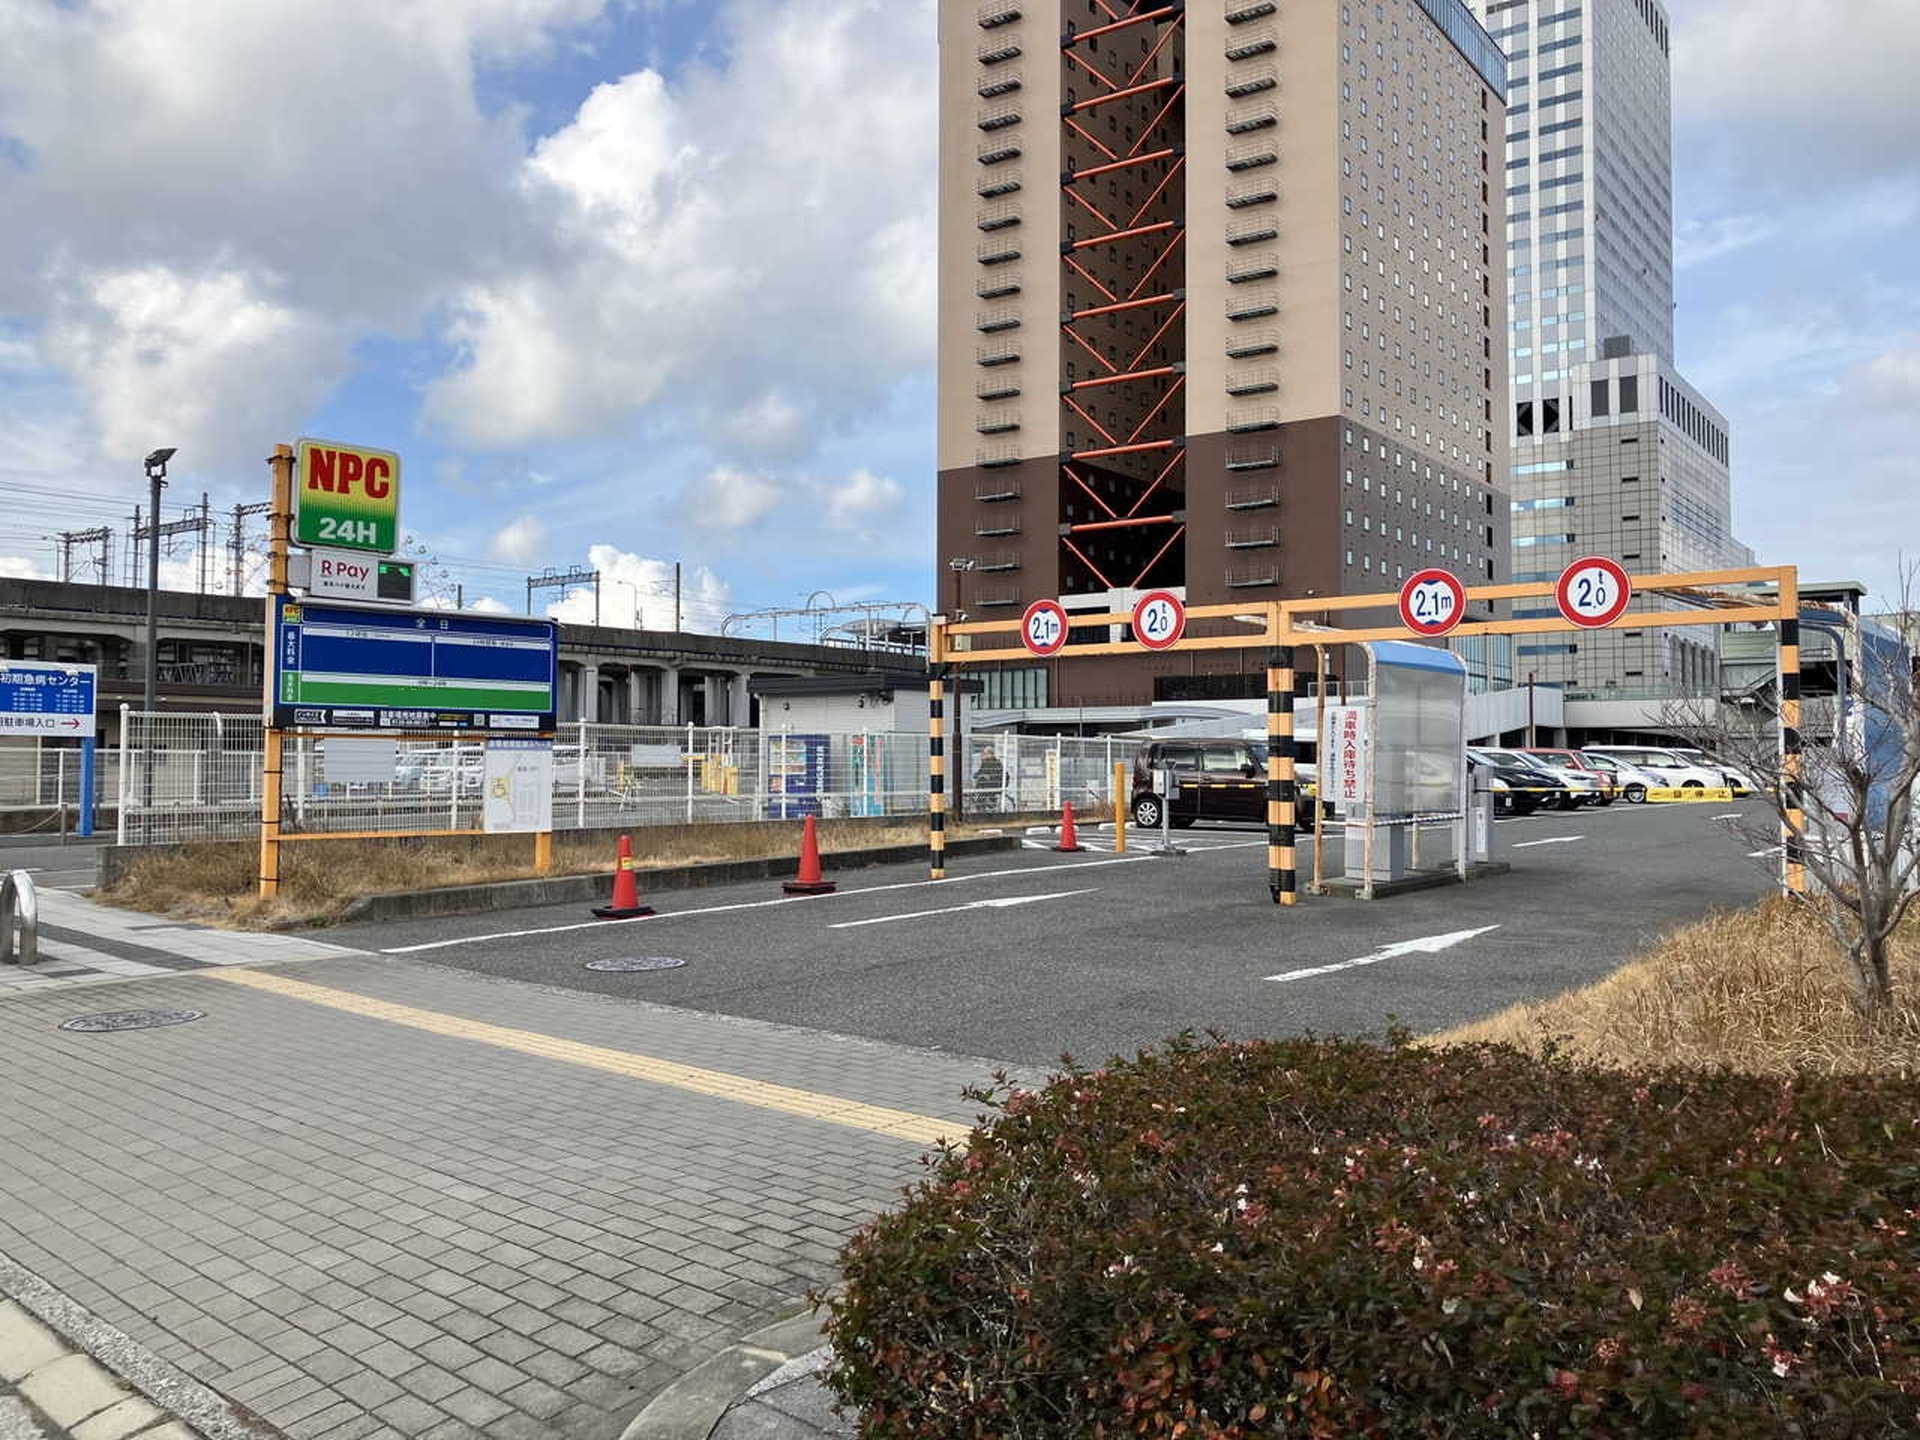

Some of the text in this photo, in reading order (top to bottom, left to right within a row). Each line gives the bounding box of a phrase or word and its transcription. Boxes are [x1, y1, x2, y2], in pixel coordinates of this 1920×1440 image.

[308, 447, 390, 499] NPC
[318, 516, 377, 545] 24H
[336, 562, 369, 582] Pay
[1415, 589, 1453, 617] 2.1m
[1032, 616, 1059, 640] 2.1m
